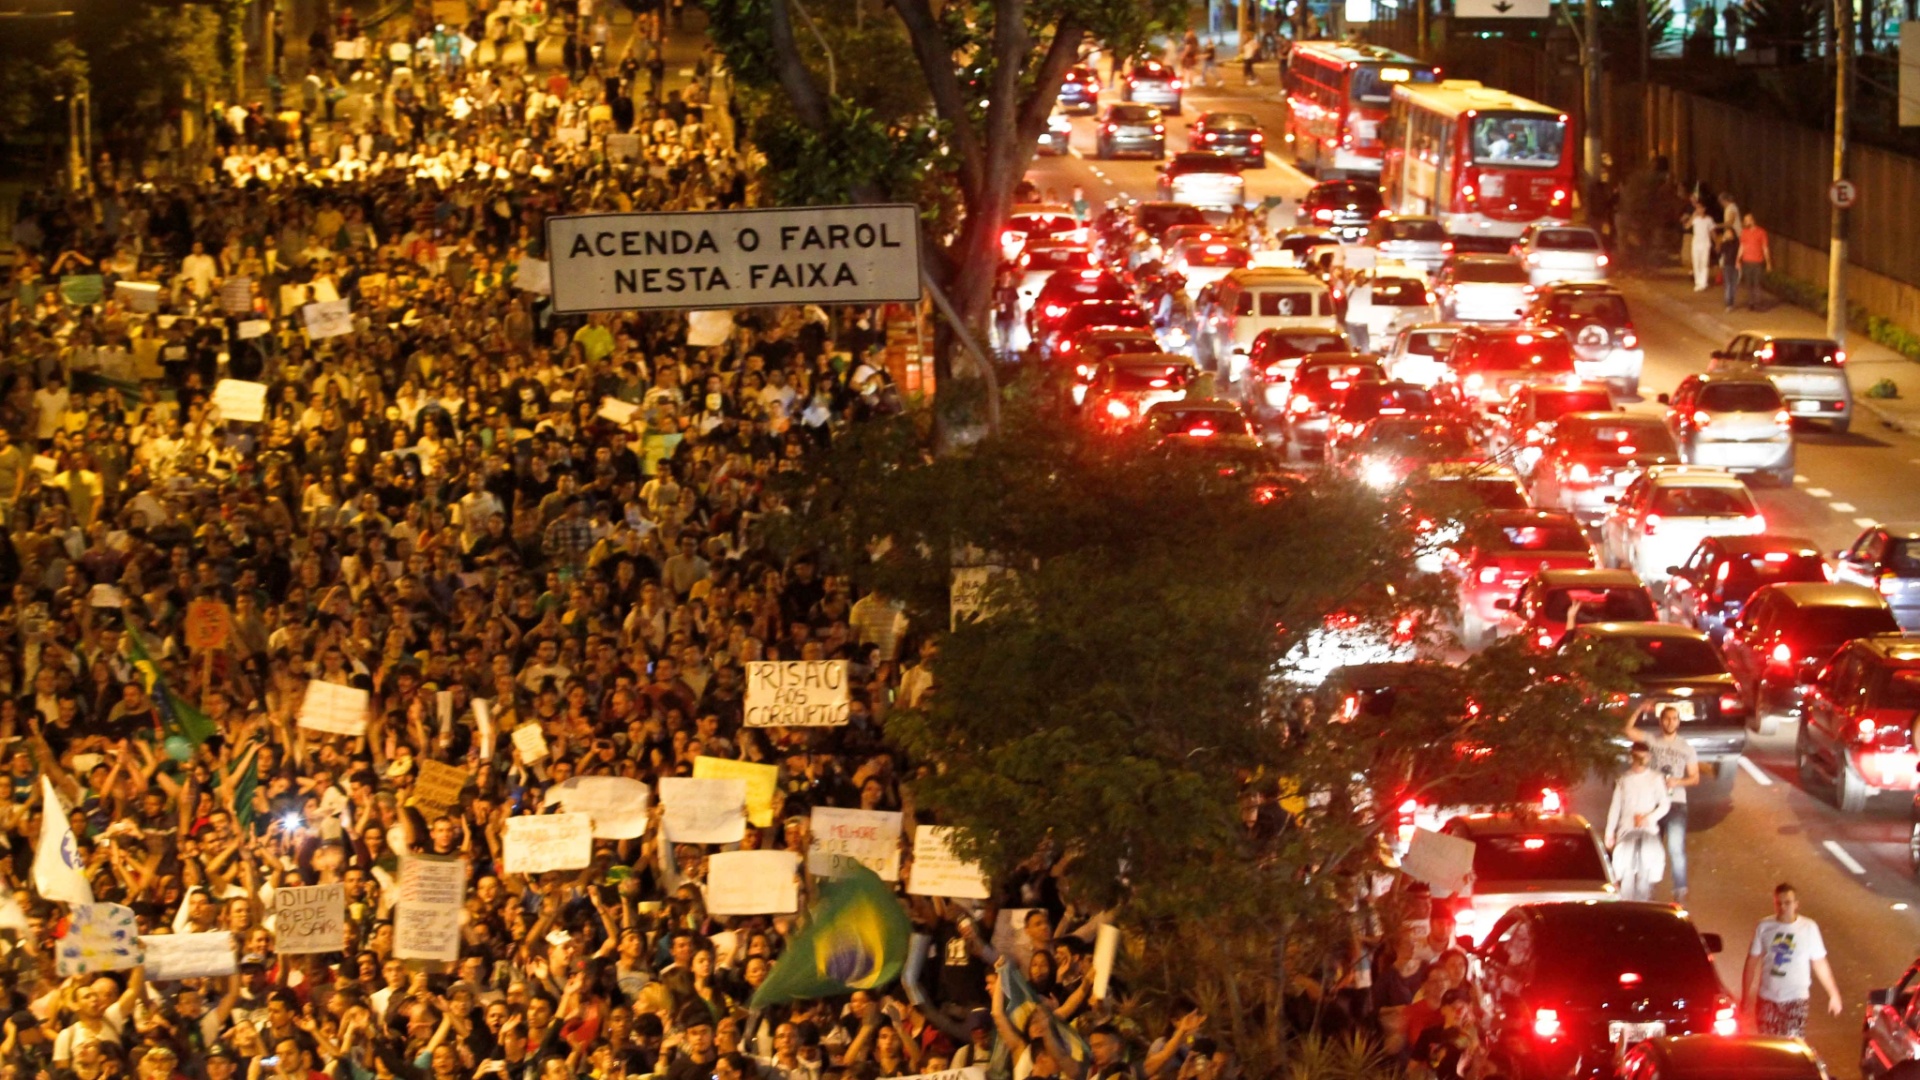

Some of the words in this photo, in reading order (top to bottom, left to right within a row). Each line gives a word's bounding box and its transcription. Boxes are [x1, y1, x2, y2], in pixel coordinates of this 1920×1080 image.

[1837, 184, 1848, 203] E
[569, 229, 720, 259] ACENDA
[737, 228, 760, 252] O
[781, 222, 901, 251] FAROL
[614, 265, 730, 295] NESTA
[749, 262, 857, 290] FAIXA
[774, 687, 808, 705] AOS
[278, 905, 327, 923] PEDE
